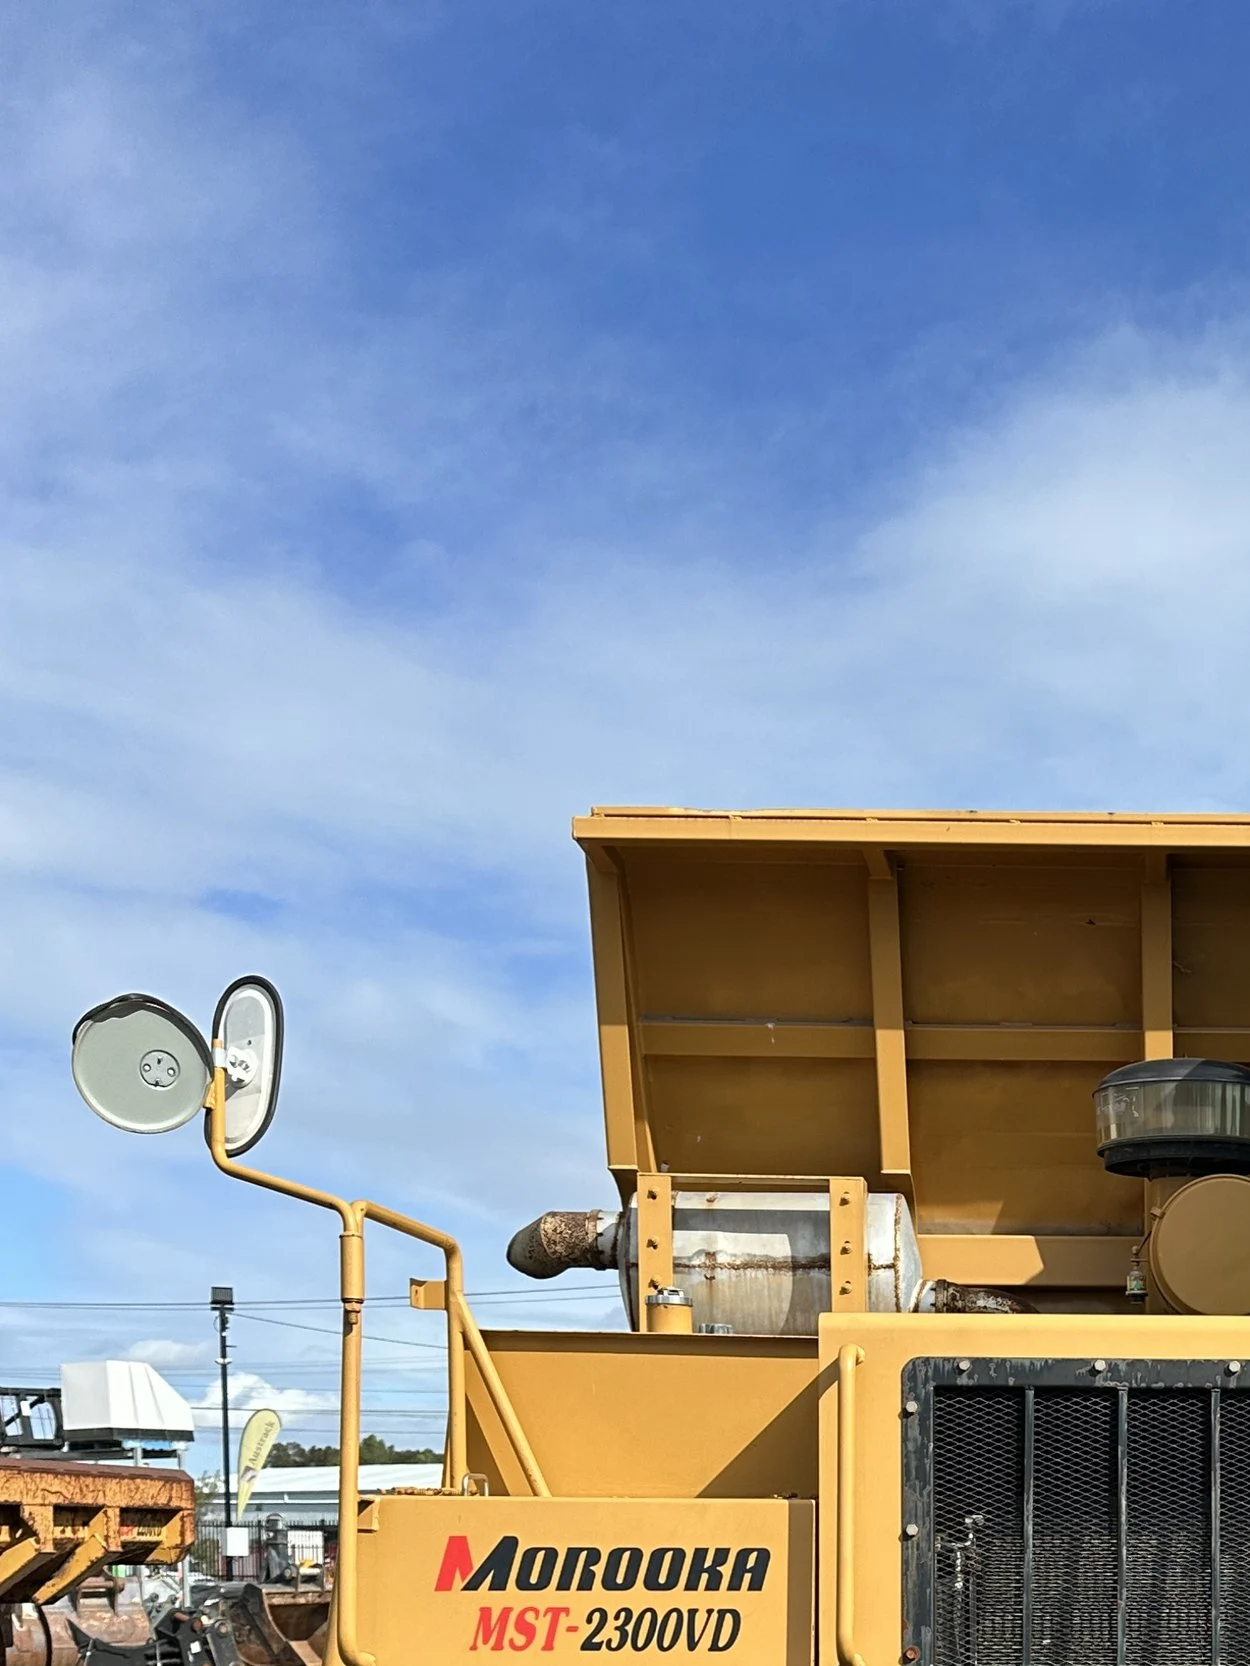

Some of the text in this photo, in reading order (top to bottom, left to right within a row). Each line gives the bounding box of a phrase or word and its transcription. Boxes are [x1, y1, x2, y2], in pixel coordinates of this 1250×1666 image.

[248, 1420, 276, 1466] Austrack
[434, 1535, 771, 1592] MOROOKA
[468, 1606, 742, 1653] MST-2300VD
